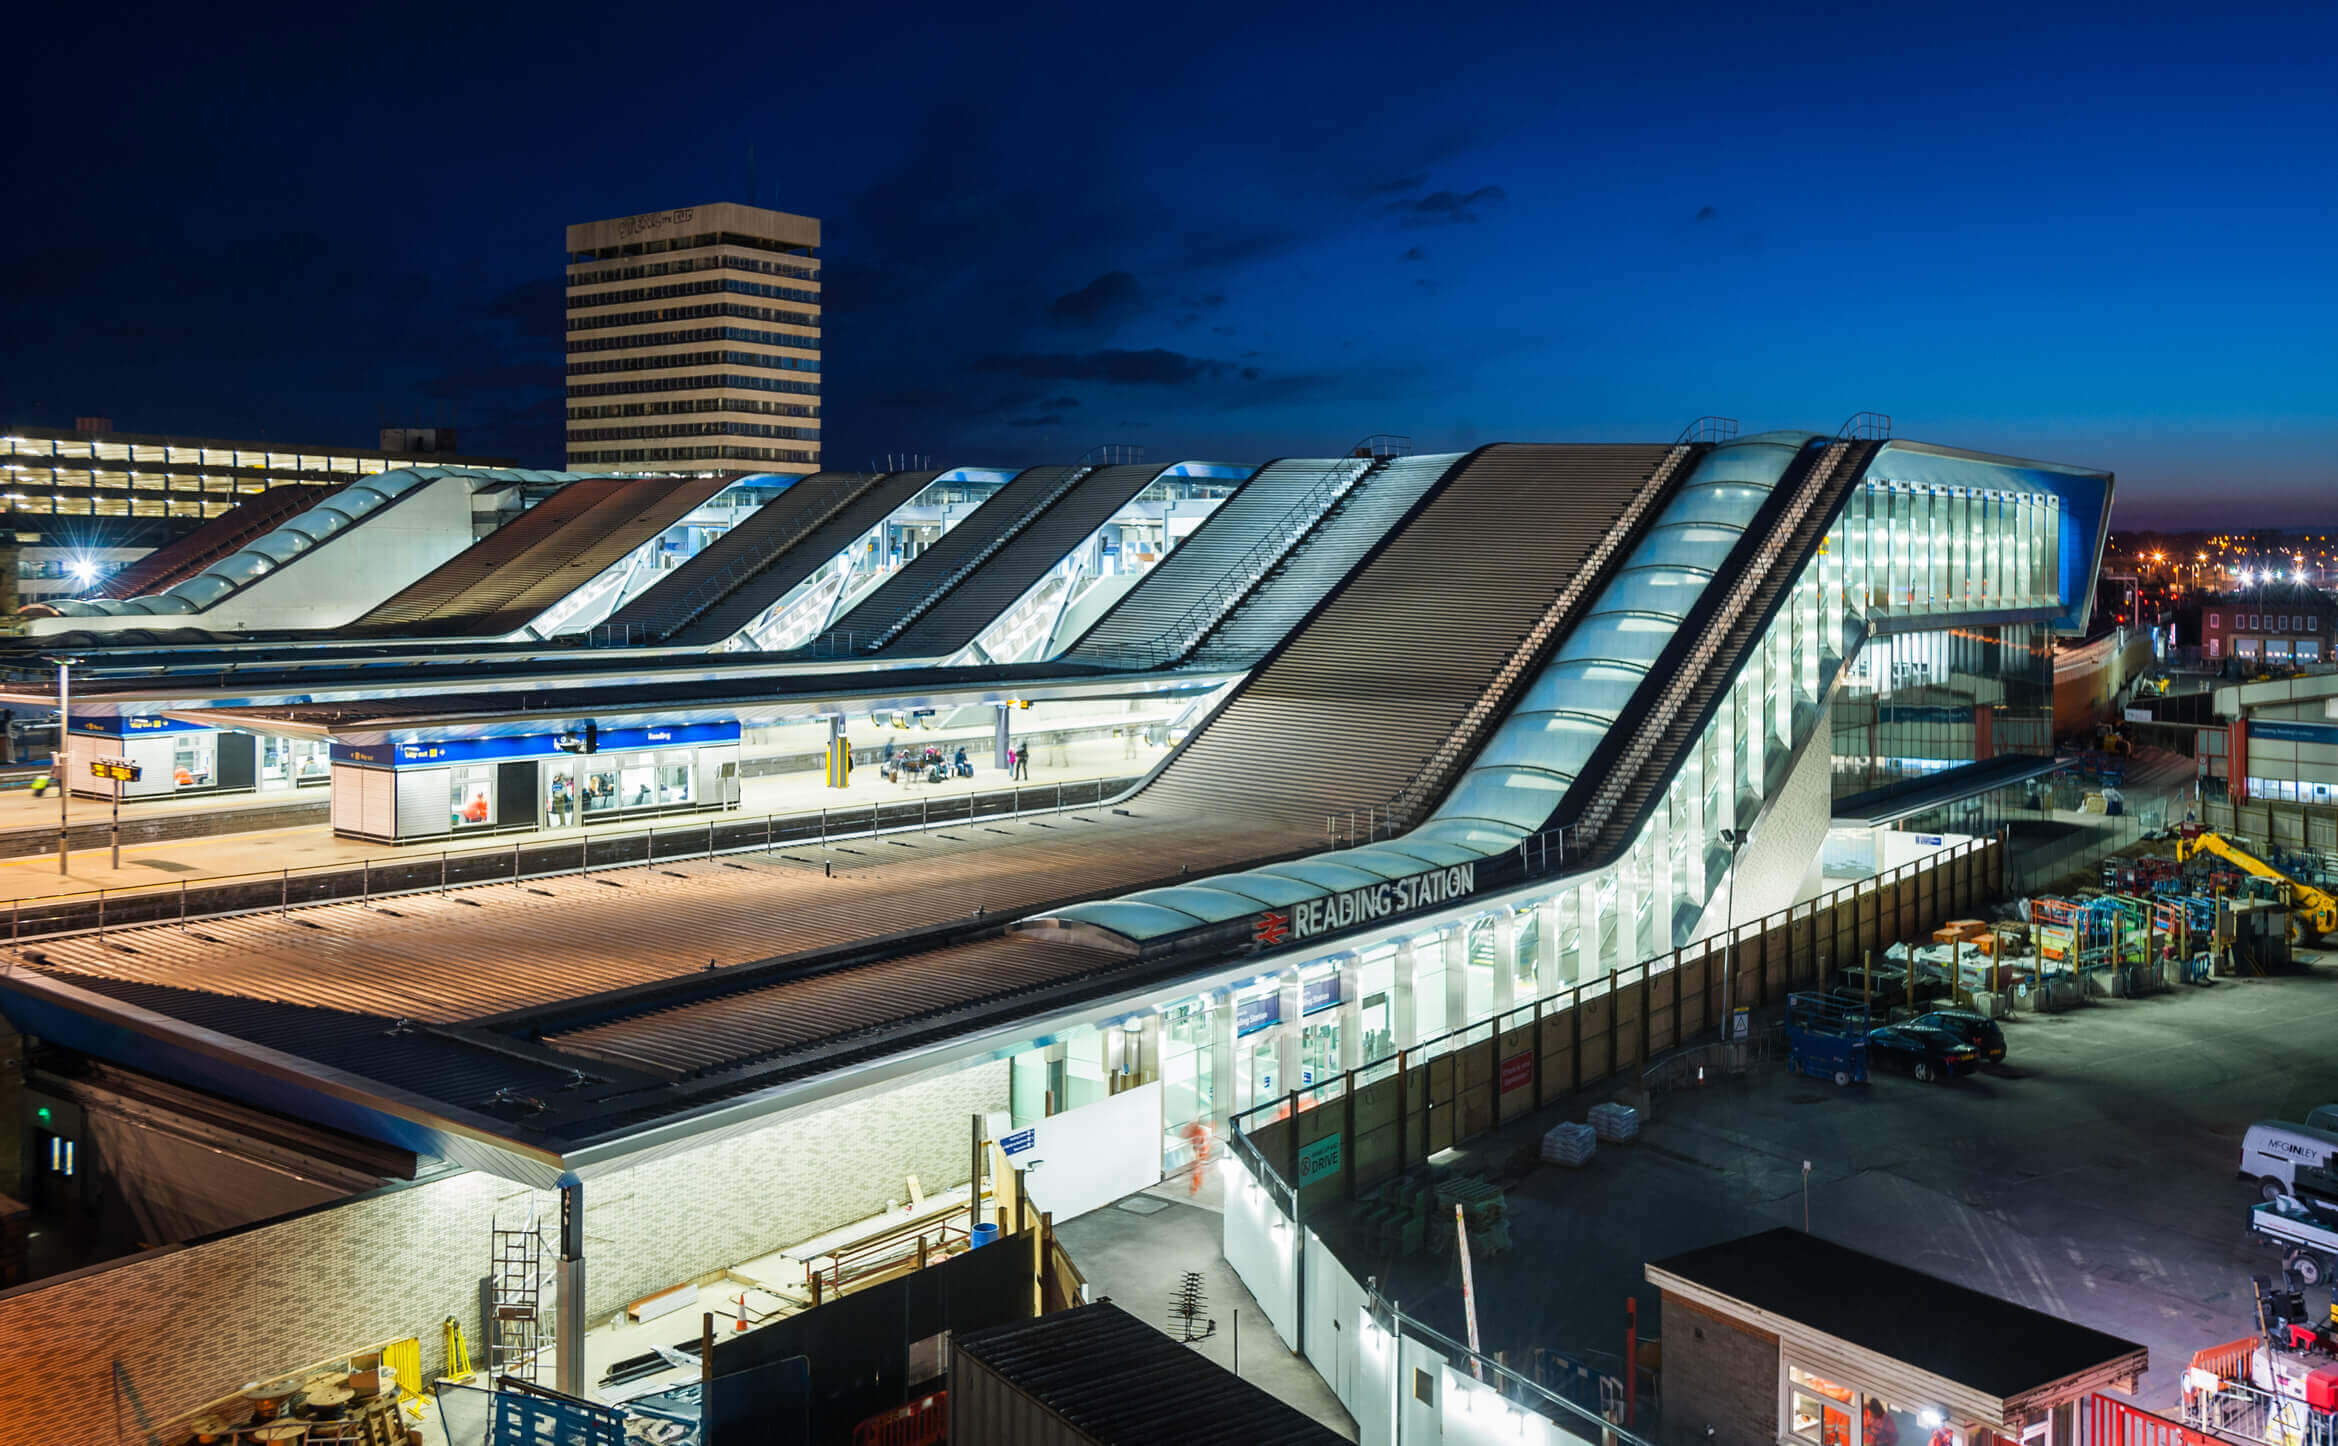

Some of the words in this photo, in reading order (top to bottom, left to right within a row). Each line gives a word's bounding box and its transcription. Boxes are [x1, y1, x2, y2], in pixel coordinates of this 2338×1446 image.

[1294, 883, 1392, 939] READING
[1396, 862, 1475, 912] STATION
[1312, 1151, 1338, 1174] DRIVE
